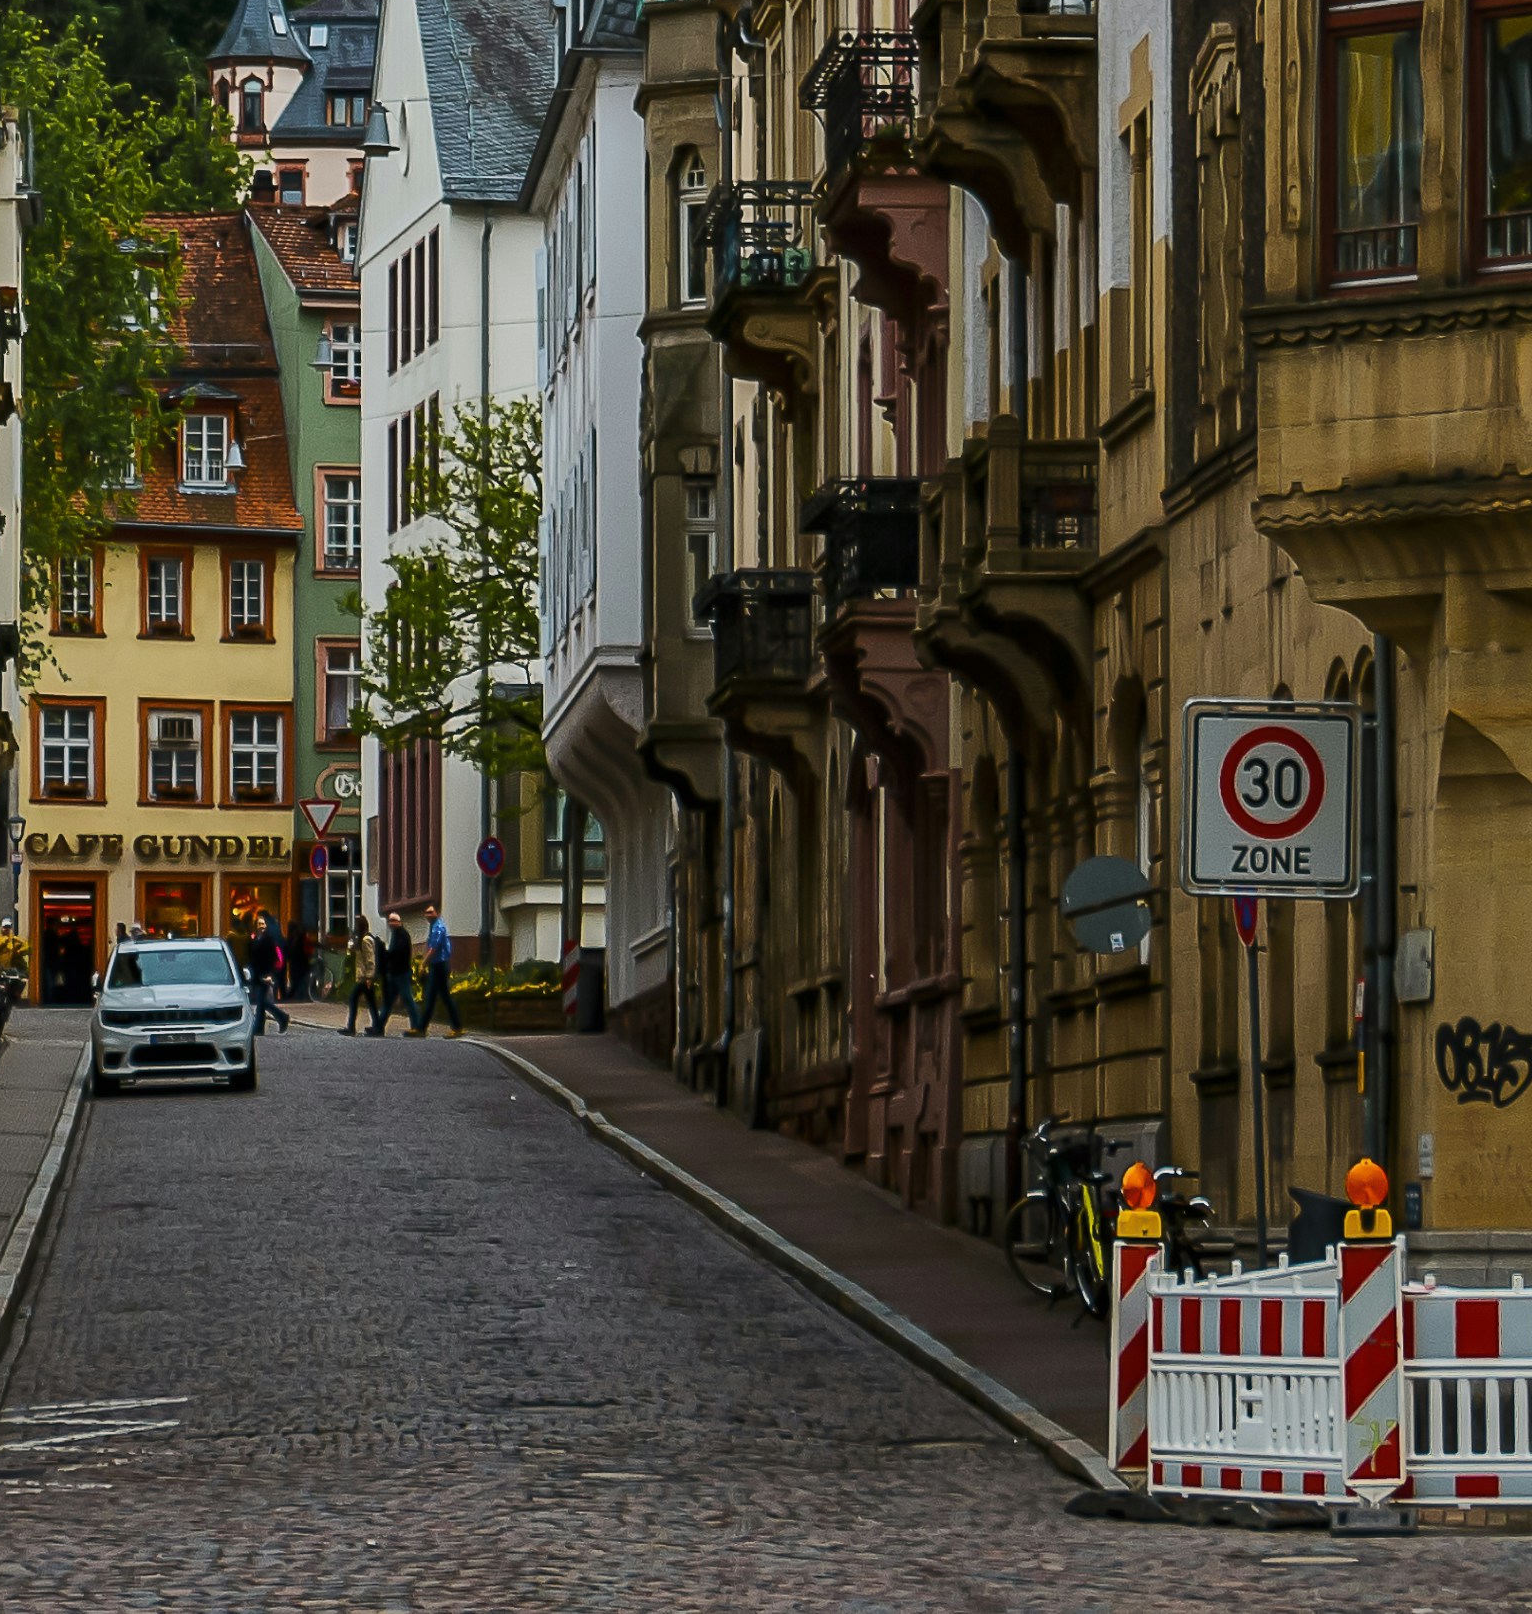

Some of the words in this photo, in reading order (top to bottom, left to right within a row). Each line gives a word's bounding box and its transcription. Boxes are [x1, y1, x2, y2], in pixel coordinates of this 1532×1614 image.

[1241, 757, 1303, 809] 30
[132, 834, 291, 860] GUNDEL
[1231, 845, 1312, 875] ZONE
